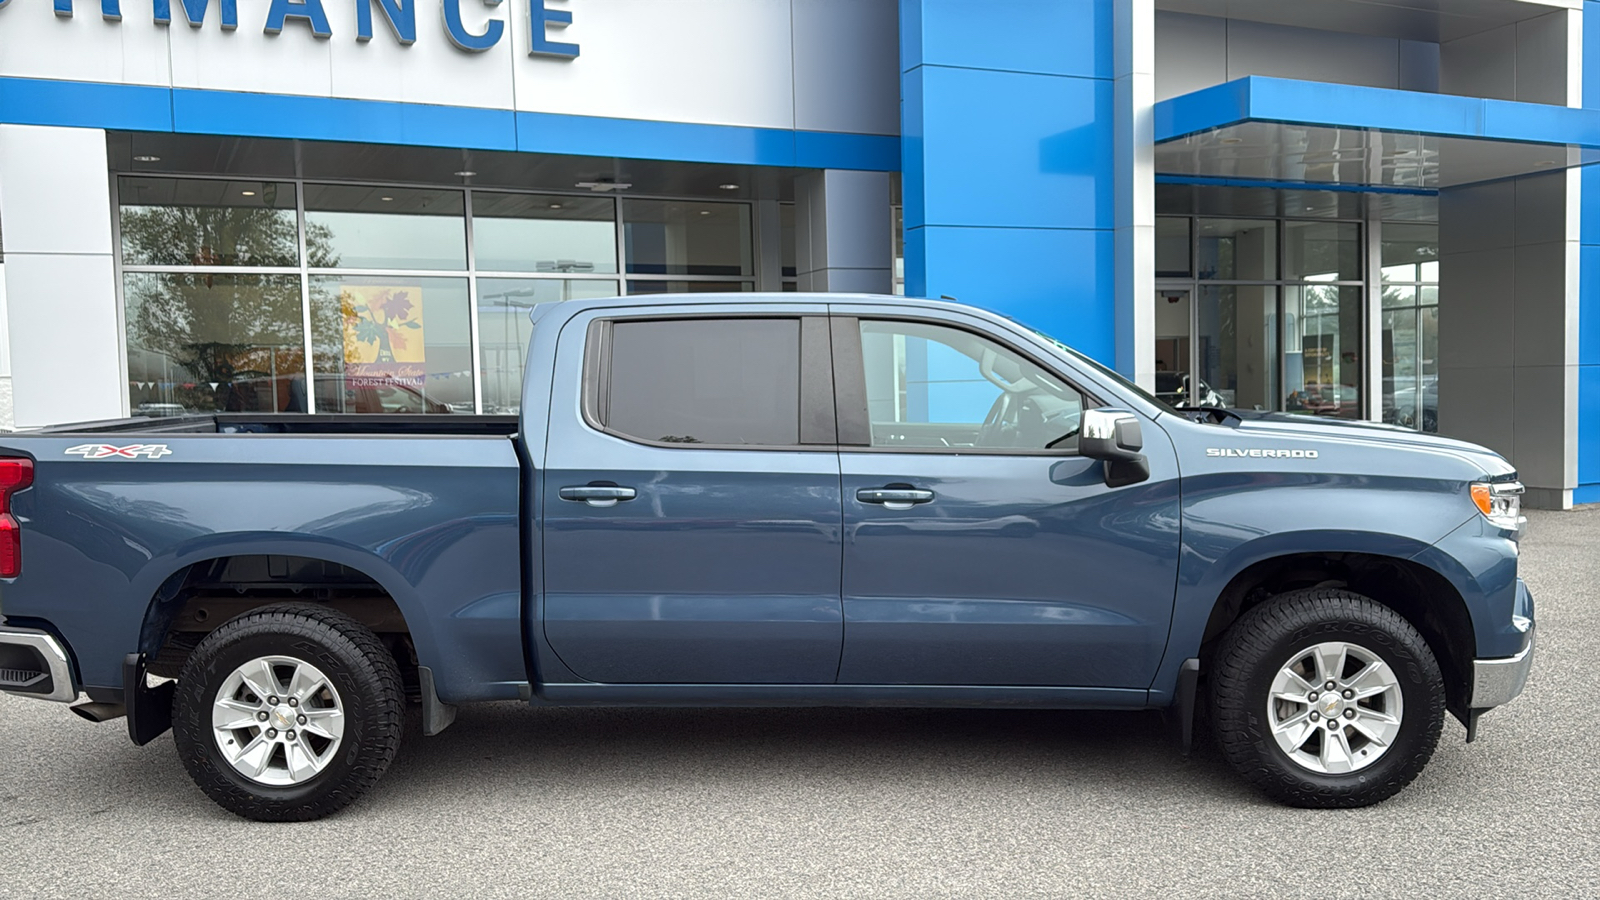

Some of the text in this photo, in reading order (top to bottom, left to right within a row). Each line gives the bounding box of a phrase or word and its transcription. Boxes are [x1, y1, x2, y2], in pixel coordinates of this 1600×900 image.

[0, 0, 580, 61] ANCE
[347, 365, 394, 377] Mountain
[352, 377, 423, 387] FOREST FESTIVAL
[1206, 448, 1319, 459] SILVERADO
[1289, 621, 1422, 684] ARROYO
